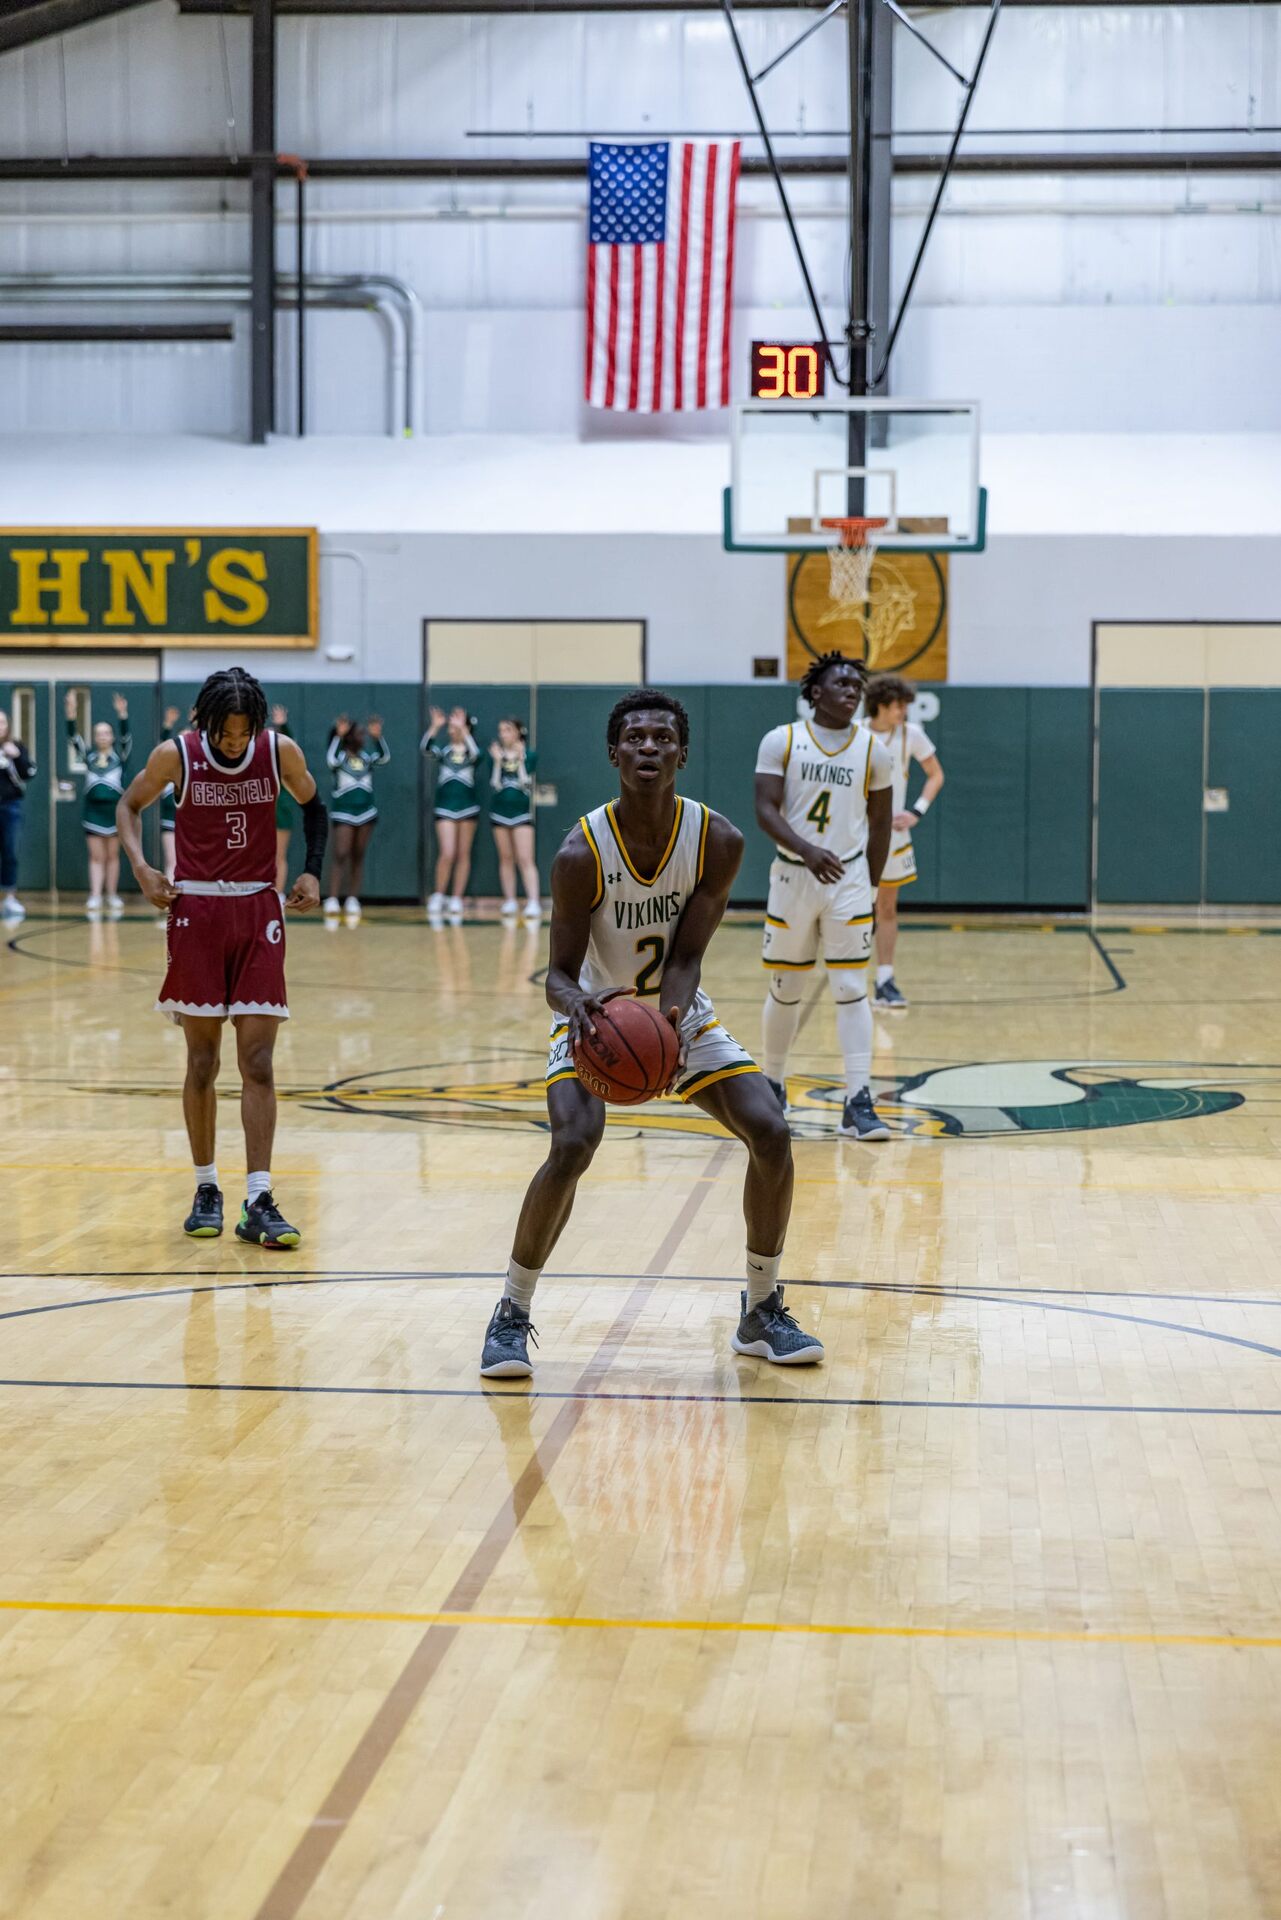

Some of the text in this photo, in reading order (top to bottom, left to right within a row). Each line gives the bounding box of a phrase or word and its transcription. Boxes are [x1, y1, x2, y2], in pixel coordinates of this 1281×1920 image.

[758, 346, 818, 399] 30
[9, 538, 269, 626] HN'S
[191, 777, 275, 807] GERSTELL
[800, 761, 855, 788] VIKINGS
[225, 811, 247, 850] 3
[806, 788, 832, 834] 4
[633, 934, 666, 998] 2
